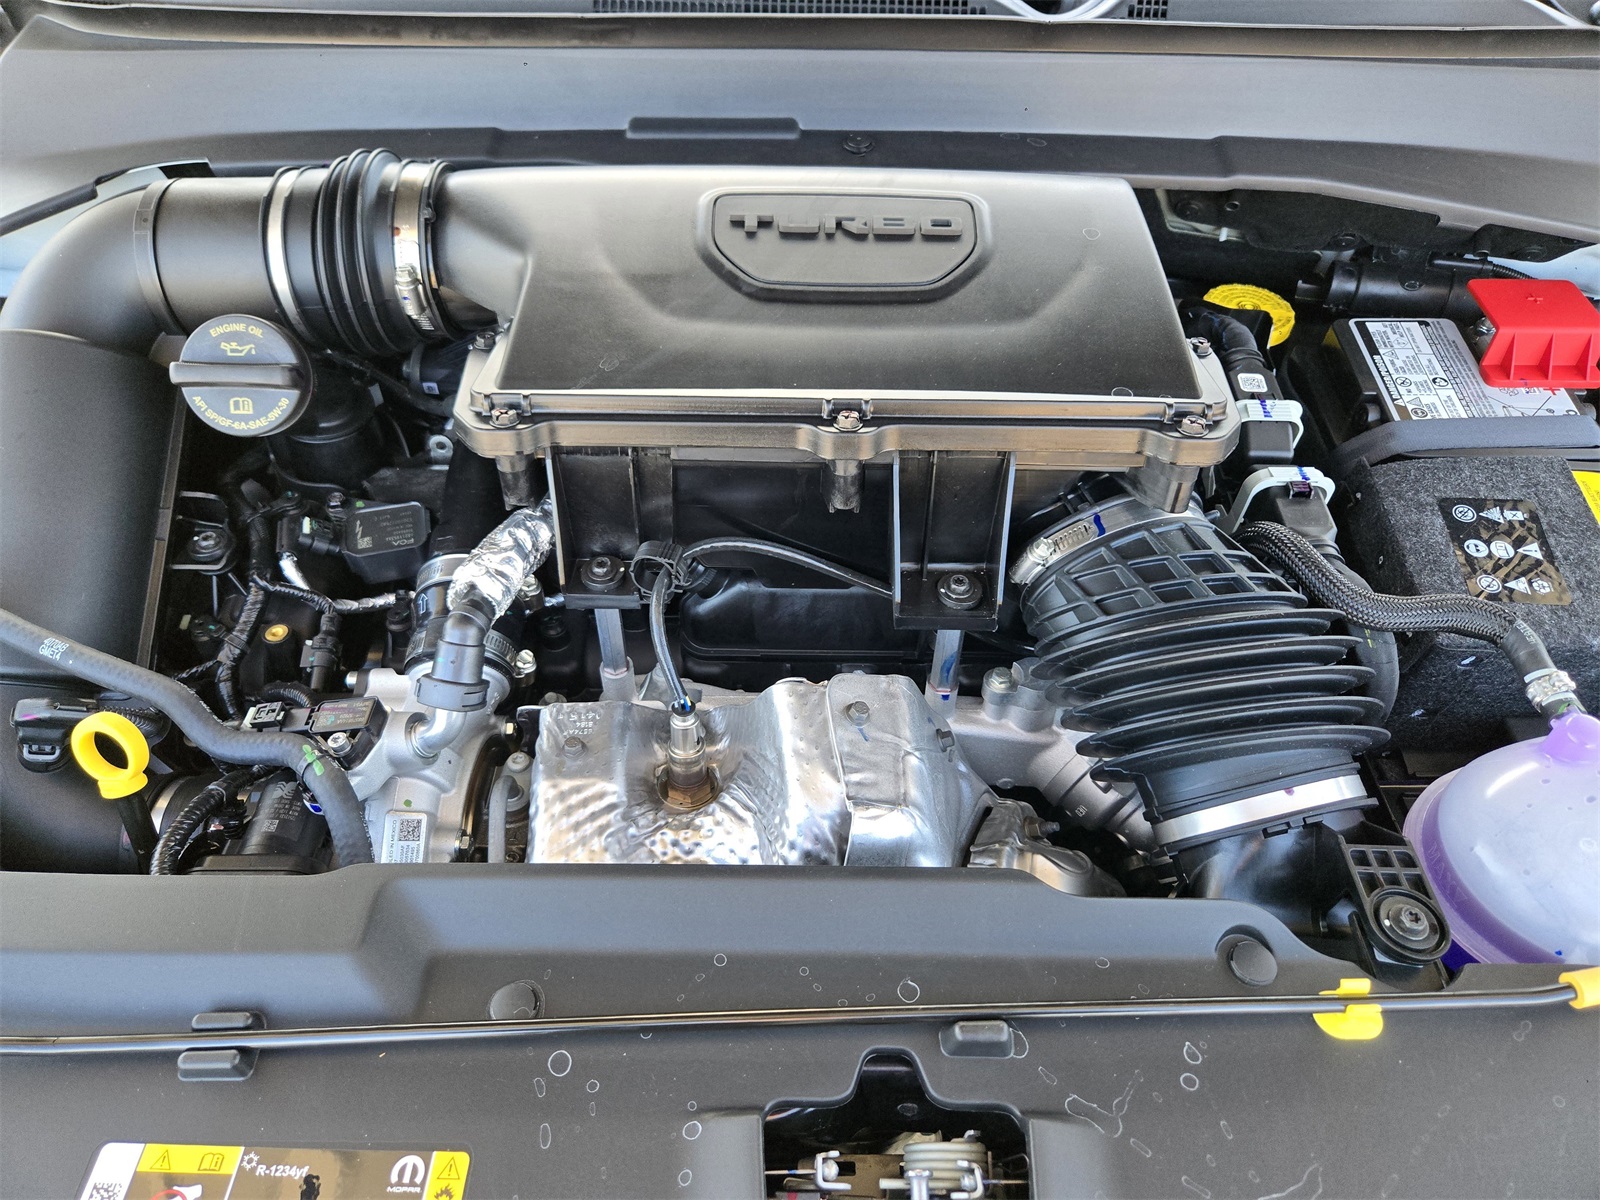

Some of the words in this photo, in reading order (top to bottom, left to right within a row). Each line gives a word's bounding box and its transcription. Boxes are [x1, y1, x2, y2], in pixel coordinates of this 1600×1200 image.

[730, 214, 962, 236] TURBO
[210, 322, 246, 338] ENGINE
[248, 325, 264, 338] OIL
[192, 395, 208, 412] API
[256, 1164, 310, 1179] R-1234yf
